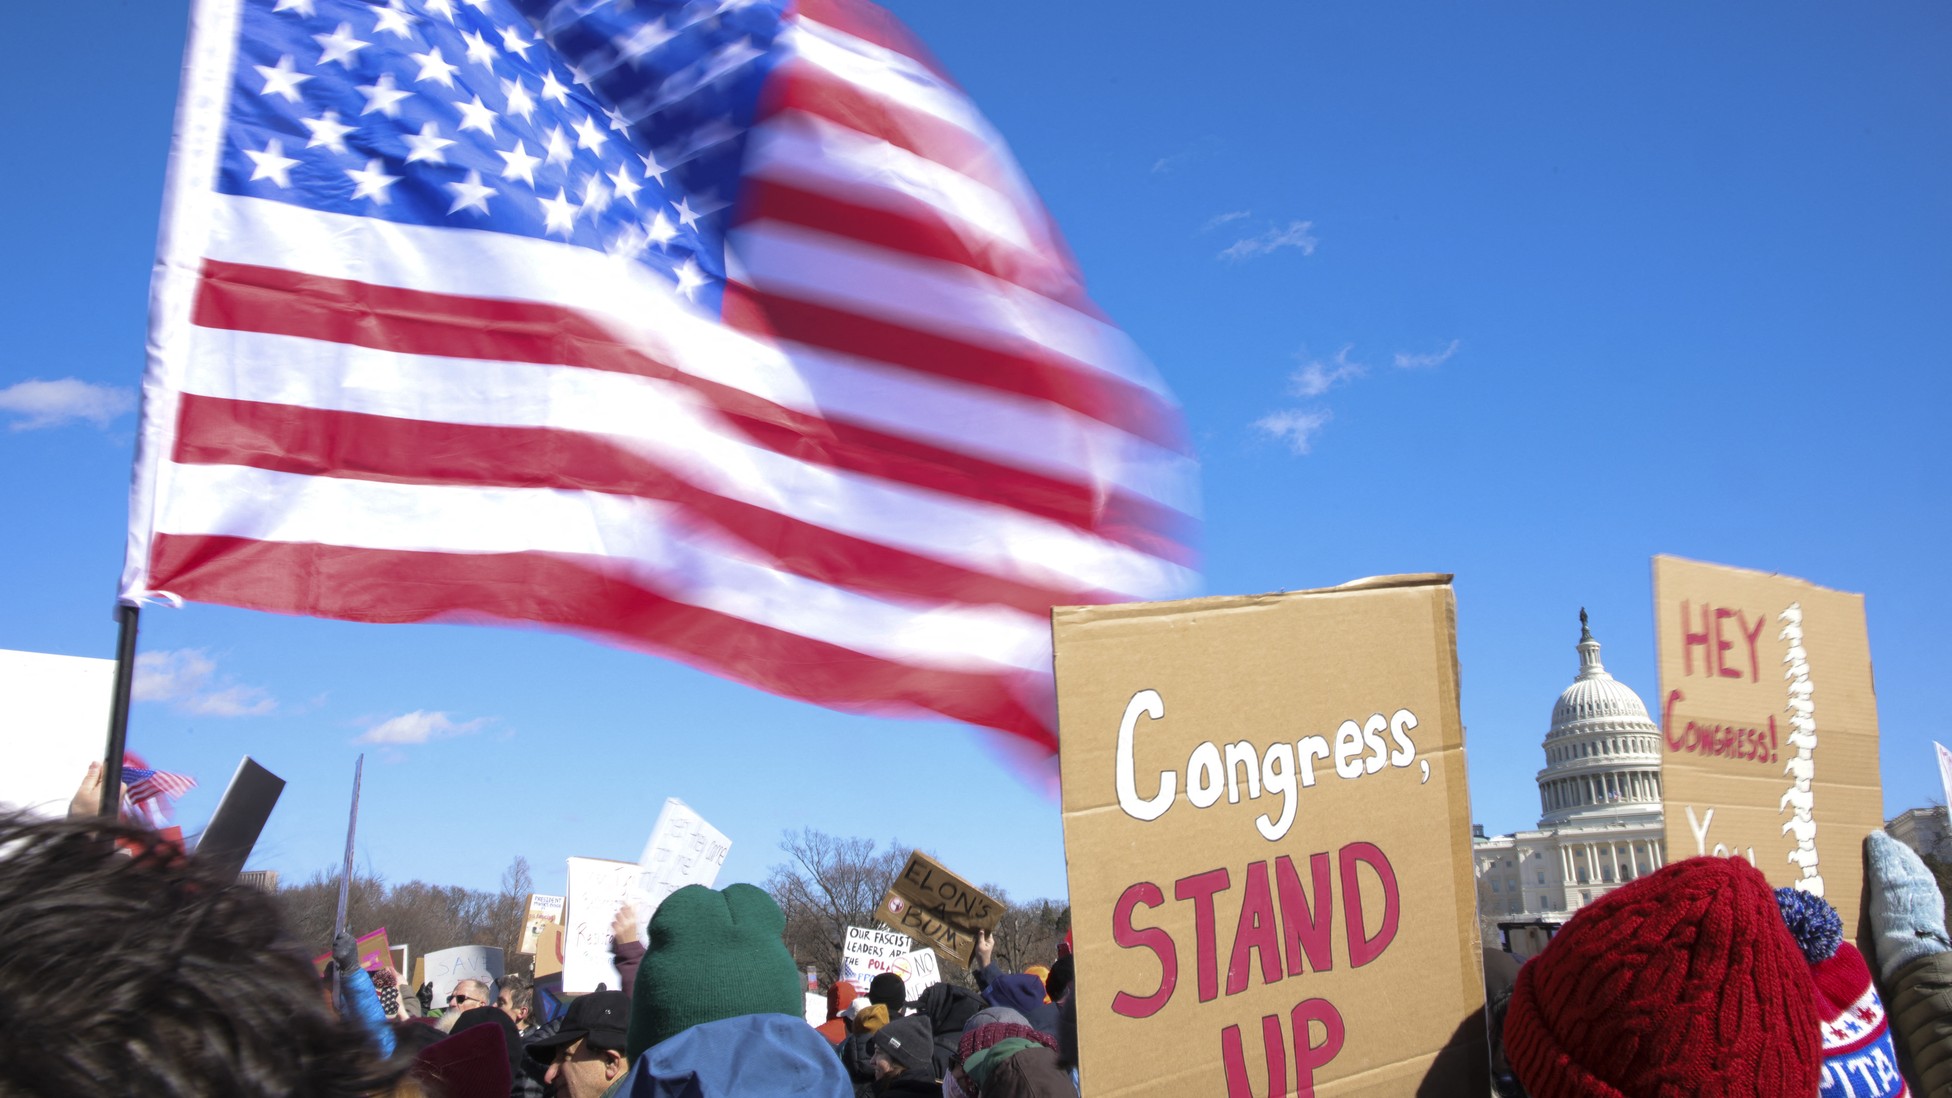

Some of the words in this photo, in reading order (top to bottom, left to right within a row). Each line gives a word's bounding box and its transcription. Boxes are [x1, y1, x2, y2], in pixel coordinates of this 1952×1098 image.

[1680, 599, 1767, 683] HEY
[1115, 688, 1431, 842] Congress,
[905, 859, 992, 919] ELON'S
[846, 941, 884, 957] LEADERS
[850, 927, 870, 941] OUR
[874, 932, 912, 947] FASCIST
[901, 906, 957, 951] BUM
[1111, 841, 1400, 1018] STAND
[845, 956, 859, 965] THE
[914, 953, 934, 976] NO
[1222, 998, 1345, 1098] UP
